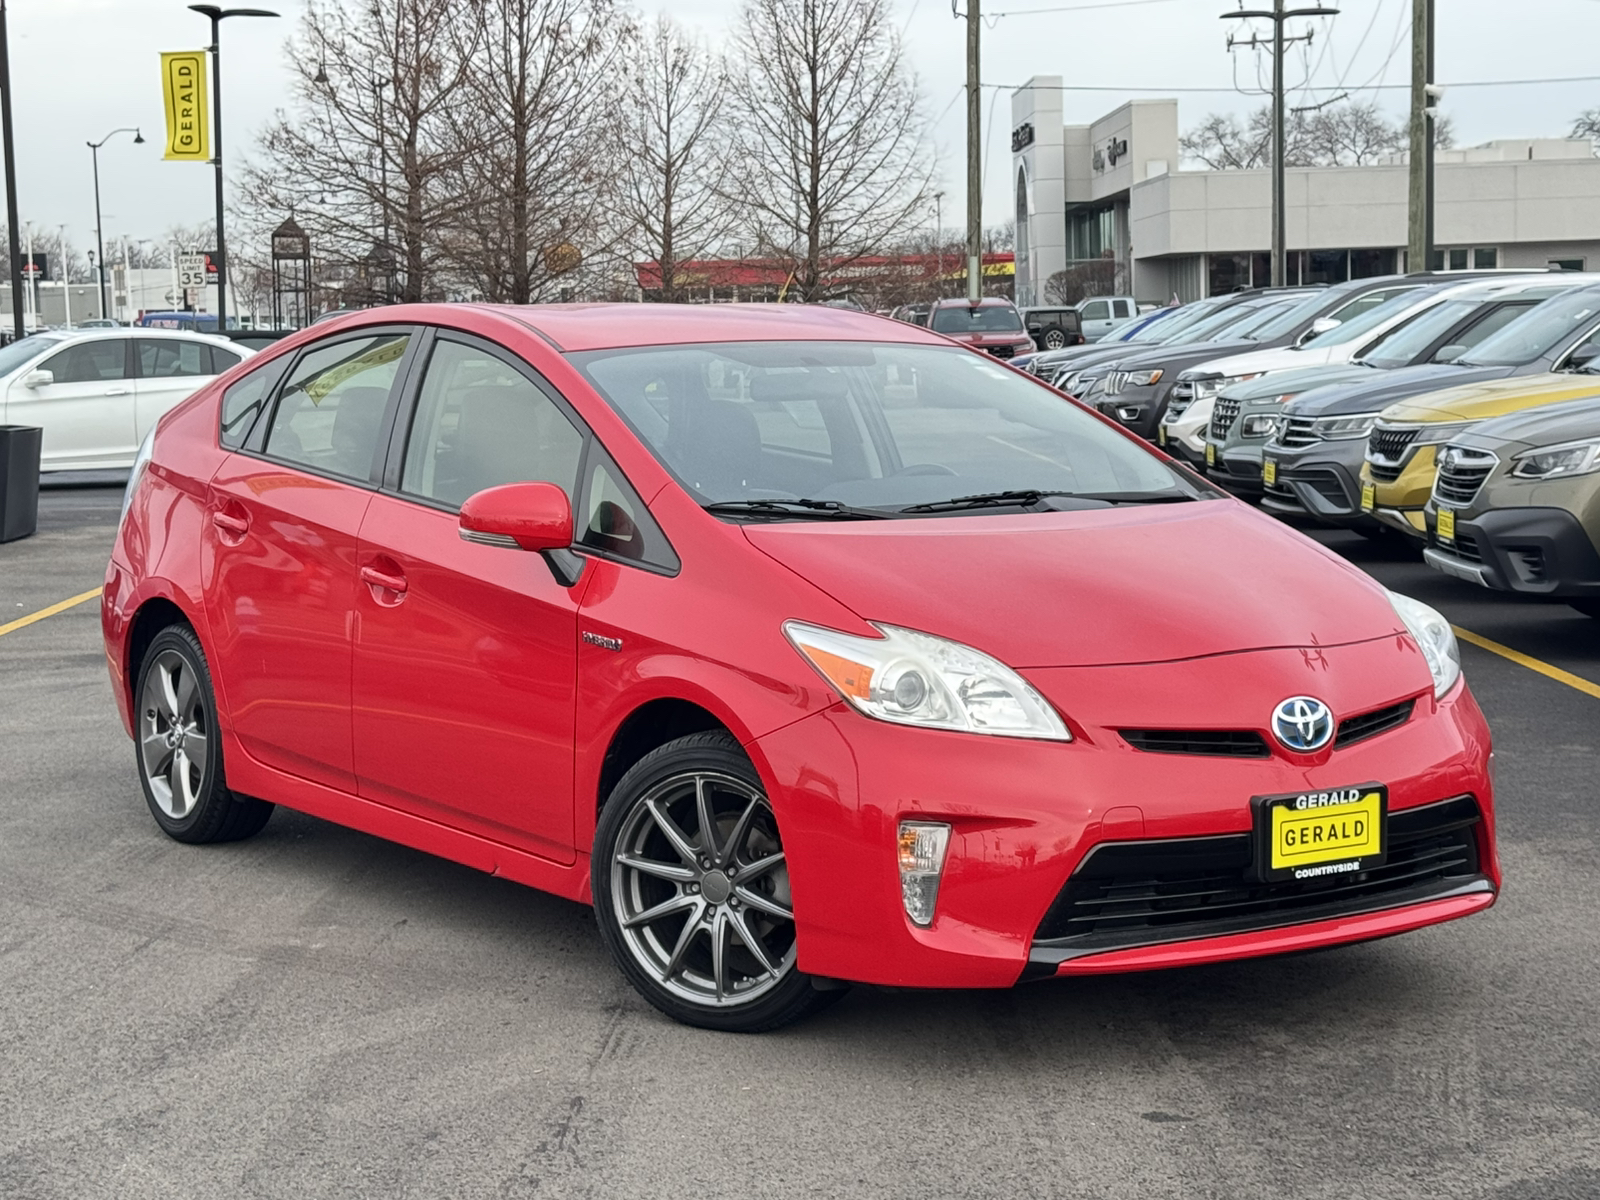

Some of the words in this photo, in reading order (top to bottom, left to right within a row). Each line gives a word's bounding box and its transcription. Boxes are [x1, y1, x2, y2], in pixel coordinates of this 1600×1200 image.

[178, 66, 193, 146] GERALD
[181, 272, 204, 285] 35
[1296, 789, 1360, 810] GERALD
[1285, 820, 1364, 847] GERALD
[1295, 861, 1360, 879] COUNTRYSIDE
